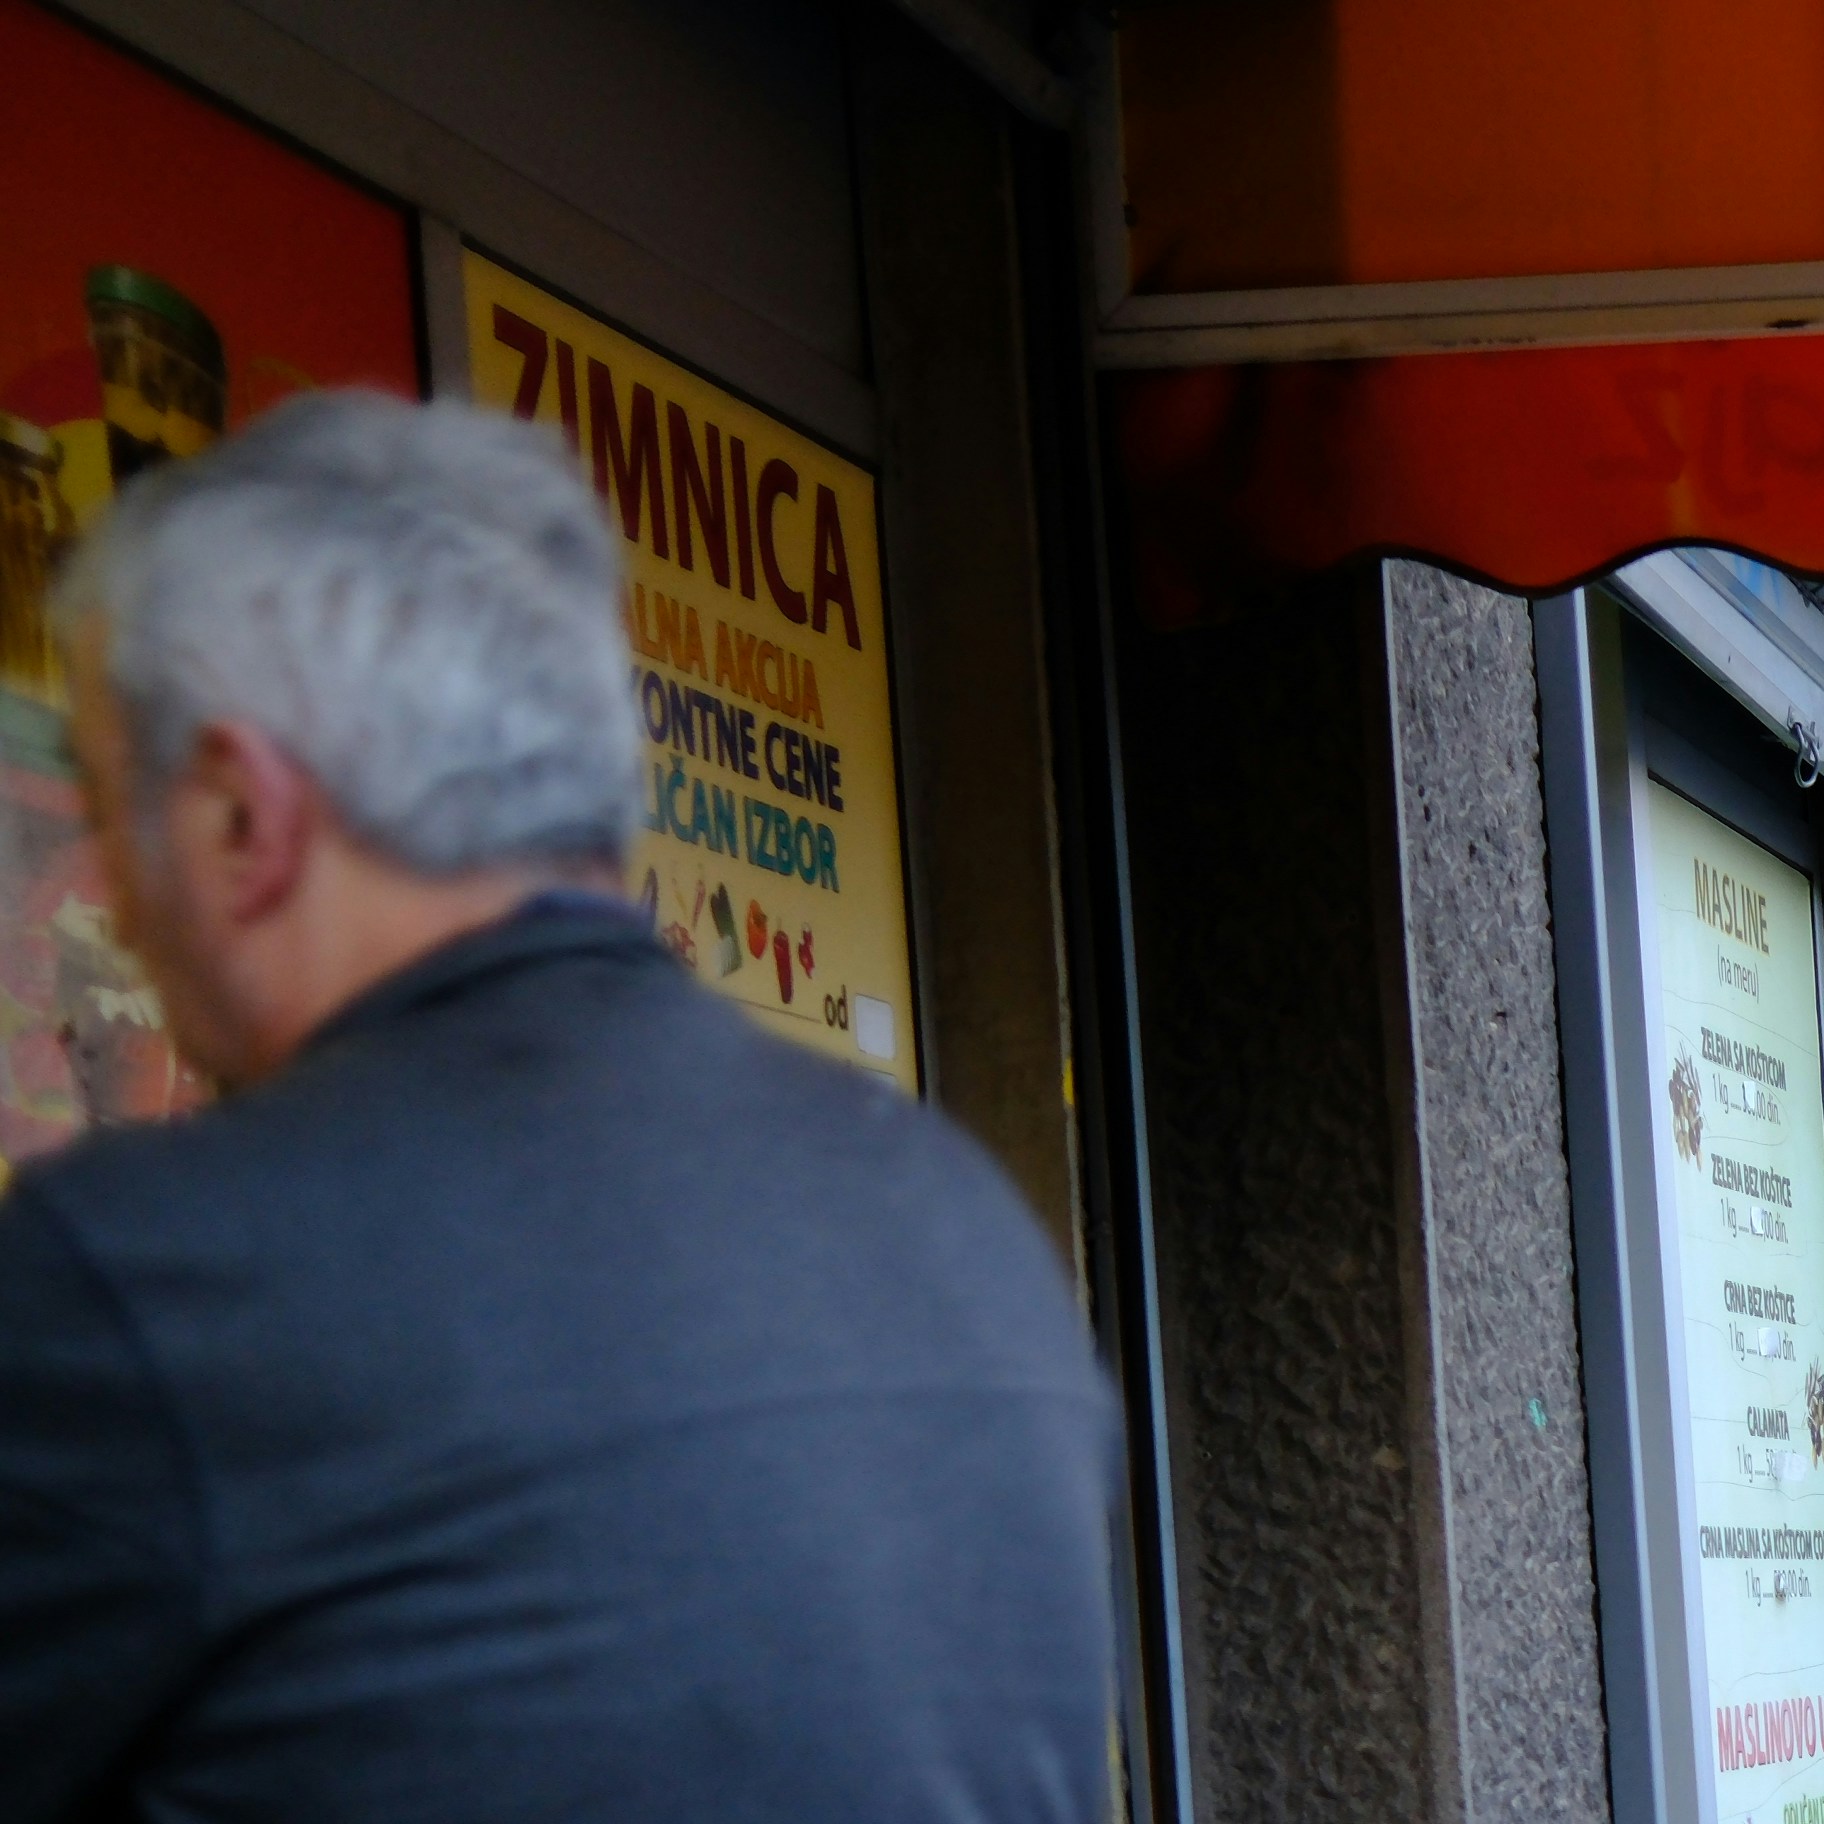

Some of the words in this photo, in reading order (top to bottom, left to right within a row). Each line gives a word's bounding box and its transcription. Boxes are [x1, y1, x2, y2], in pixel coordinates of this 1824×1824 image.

[494, 304, 862, 652] ZIMNICA
[715, 618, 826, 730] AKCIJA
[765, 719, 845, 812] CENE
[745, 796, 841, 893] IZBOR
[1693, 856, 1770, 957] MASLINE
[824, 984, 849, 1031] od
[1733, 962, 1760, 1004] meru)
[1701, 1026, 1734, 1070] ZELENA
[1733, 1040, 1746, 1075] SA
[1745, 1043, 1788, 1092] KOŠTICOM
[1711, 1153, 1744, 1194] ZELENA
[1743, 1163, 1760, 1199] BEZ
[1759, 1165, 1793, 1209] KOŠTICE
[1724, 1279, 1748, 1315] CRNA
[1747, 1284, 1764, 1319] BEZ
[1763, 1284, 1797, 1326] KOŠTICE
[1747, 1405, 1791, 1442] CALAMATA
[1700, 1525, 1724, 1559] CRNA
[1724, 1526, 1761, 1560] MASLINA
[1761, 1528, 1773, 1560] SA
[1716, 1695, 1817, 1773] MASLINOVO
